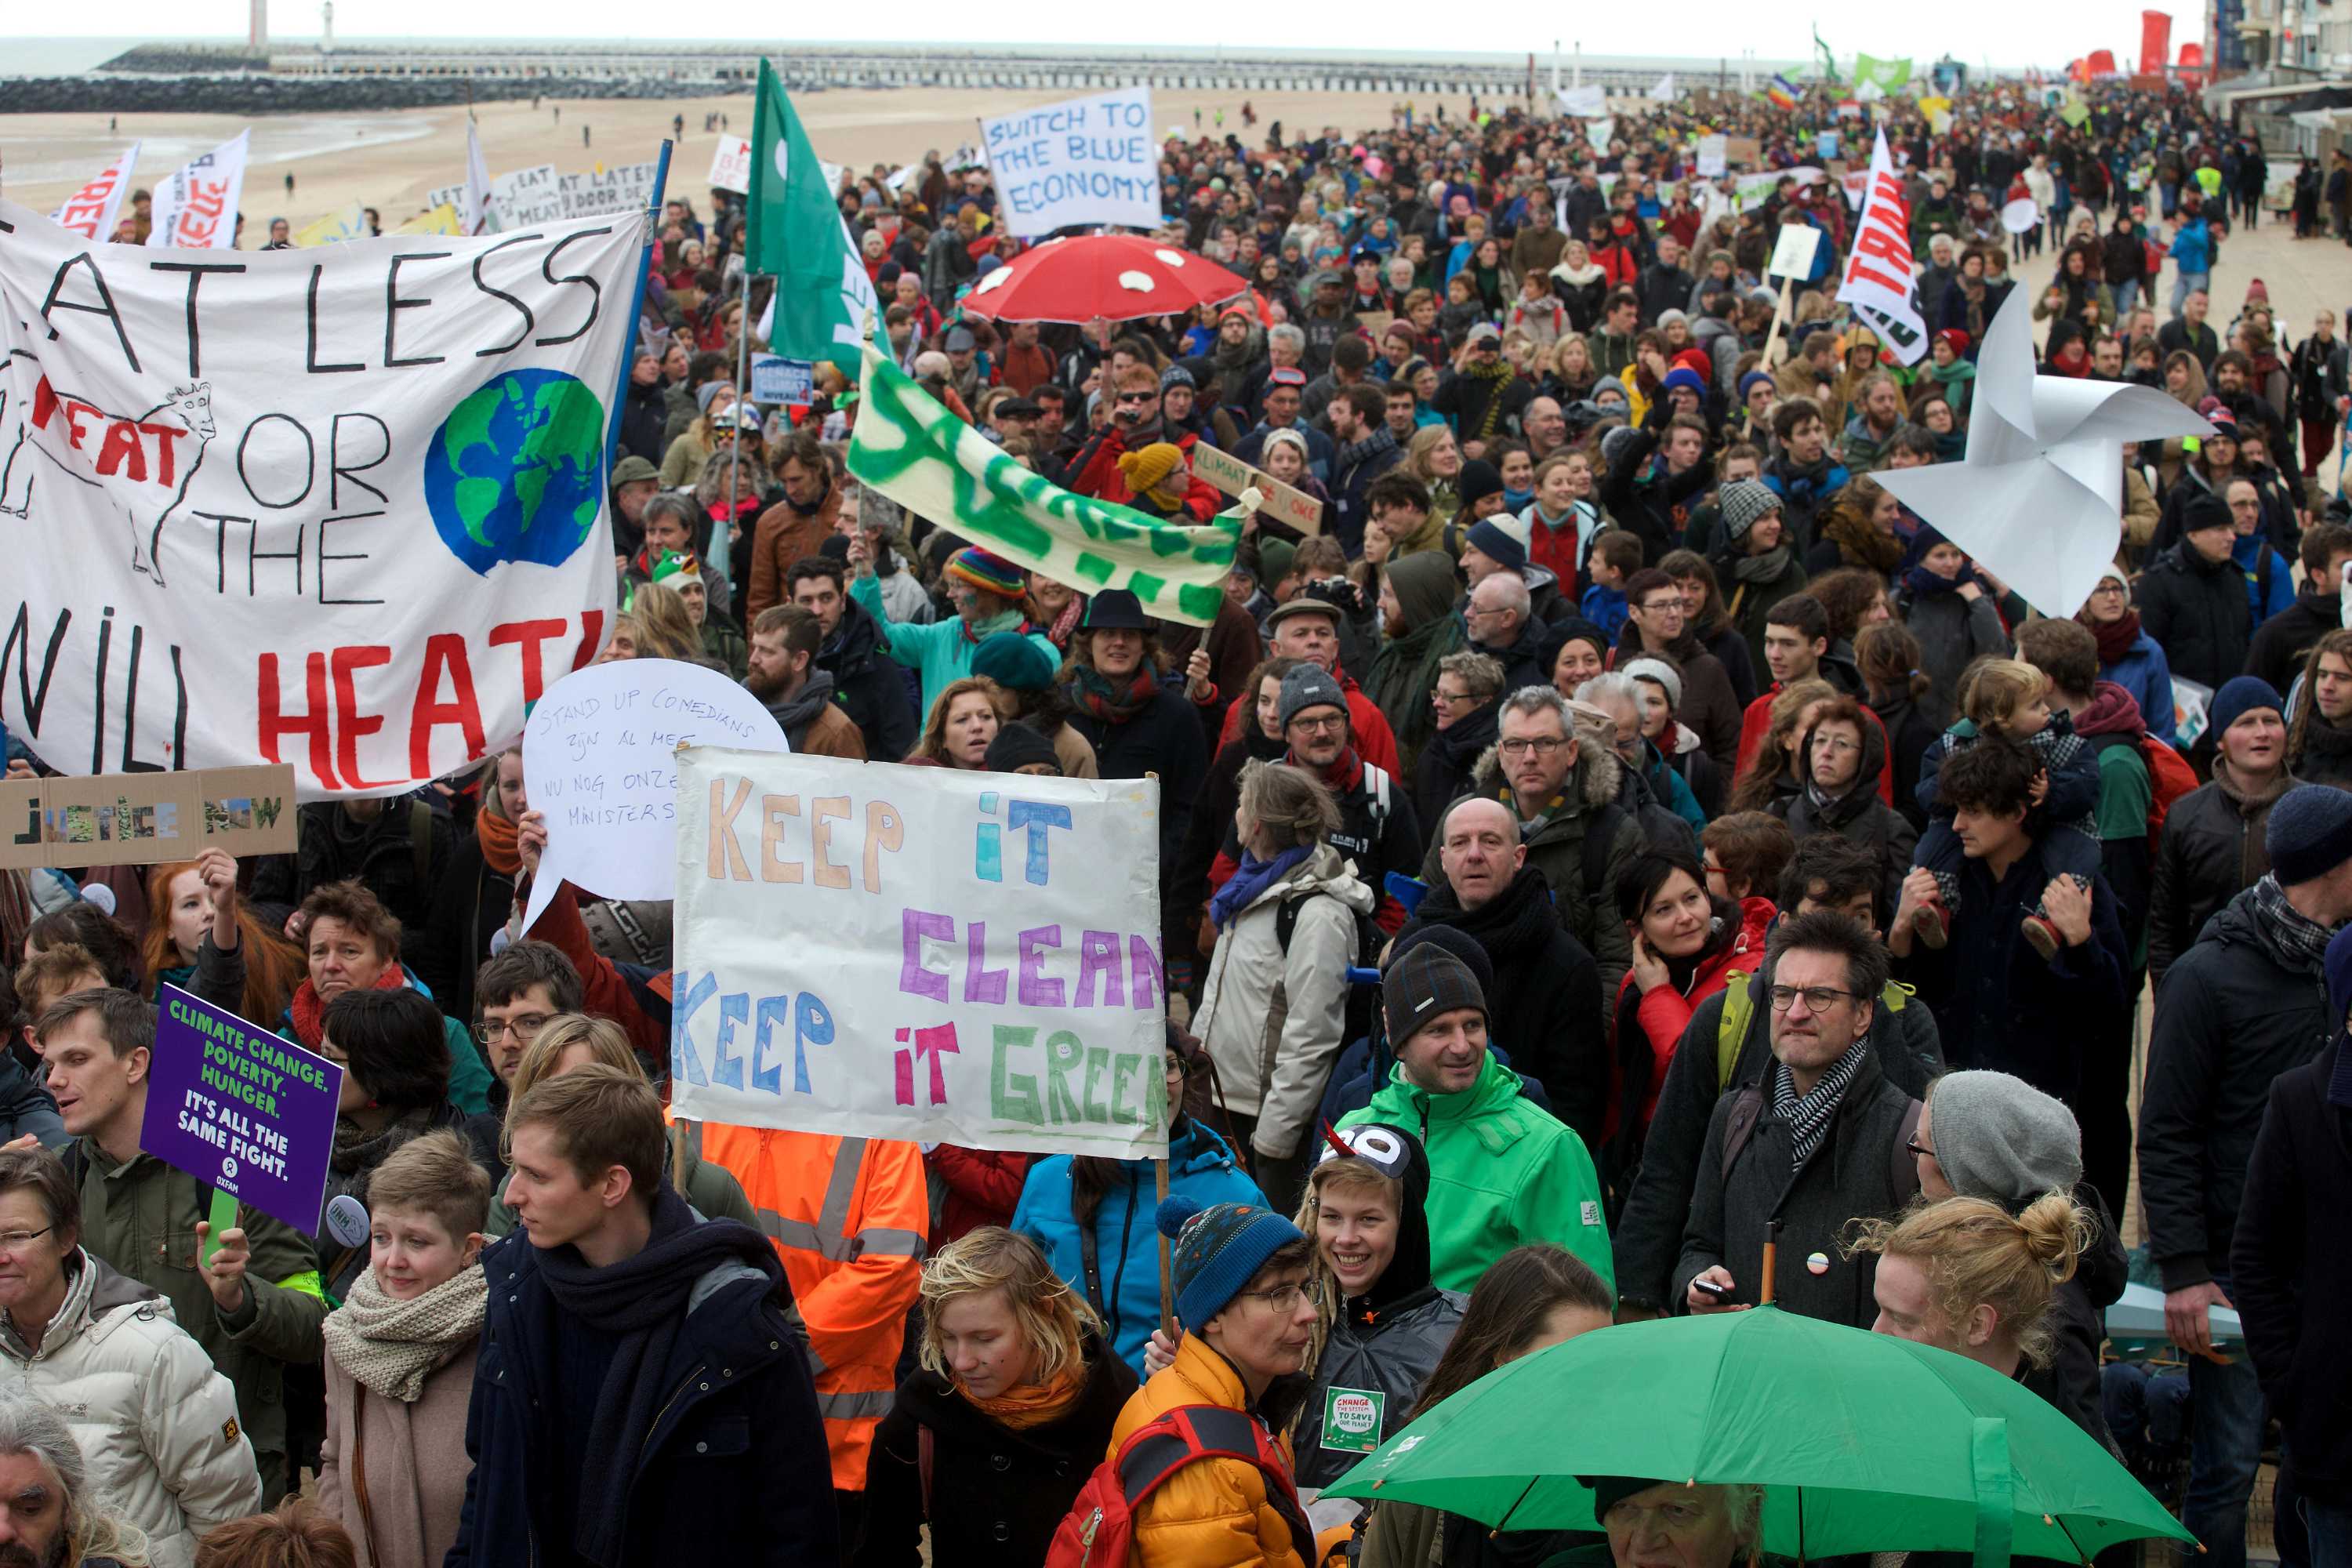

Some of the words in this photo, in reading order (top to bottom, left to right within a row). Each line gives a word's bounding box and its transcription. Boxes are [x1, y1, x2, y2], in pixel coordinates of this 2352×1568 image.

[1101, 102, 1145, 128] TO
[993, 140, 1051, 172] THE
[1067, 136, 1145, 163] BLUE
[1008, 170, 1155, 214] ECONOMY
[307, 227, 612, 374] LESS
[238, 413, 390, 510] OR
[192, 511, 386, 604] THE
[540, 698, 601, 735] STAND
[614, 689, 640, 710] UP
[618, 730, 637, 746] AL
[204, 796, 281, 833] NOW
[545, 779, 563, 797] NU
[574, 775, 604, 800] NOG
[708, 777, 904, 894] KEEP
[899, 907, 1166, 1011] CLEAN
[169, 1000, 245, 1051] CLIMATE
[249, 1038, 328, 1092] CHANGE.
[203, 1039, 286, 1097] POVERTY.
[672, 969, 836, 1096] KEEP
[990, 1023, 1169, 1133] GREEN
[201, 1064, 281, 1119] HUNGER.
[178, 1110, 227, 1149] SAME
[230, 1135, 289, 1181] FIGHT.
[185, 1089, 217, 1120] IT'S
[219, 1107, 250, 1137] ALL
[255, 1123, 289, 1156] THE
[216, 1175, 239, 1194] OXFAM
